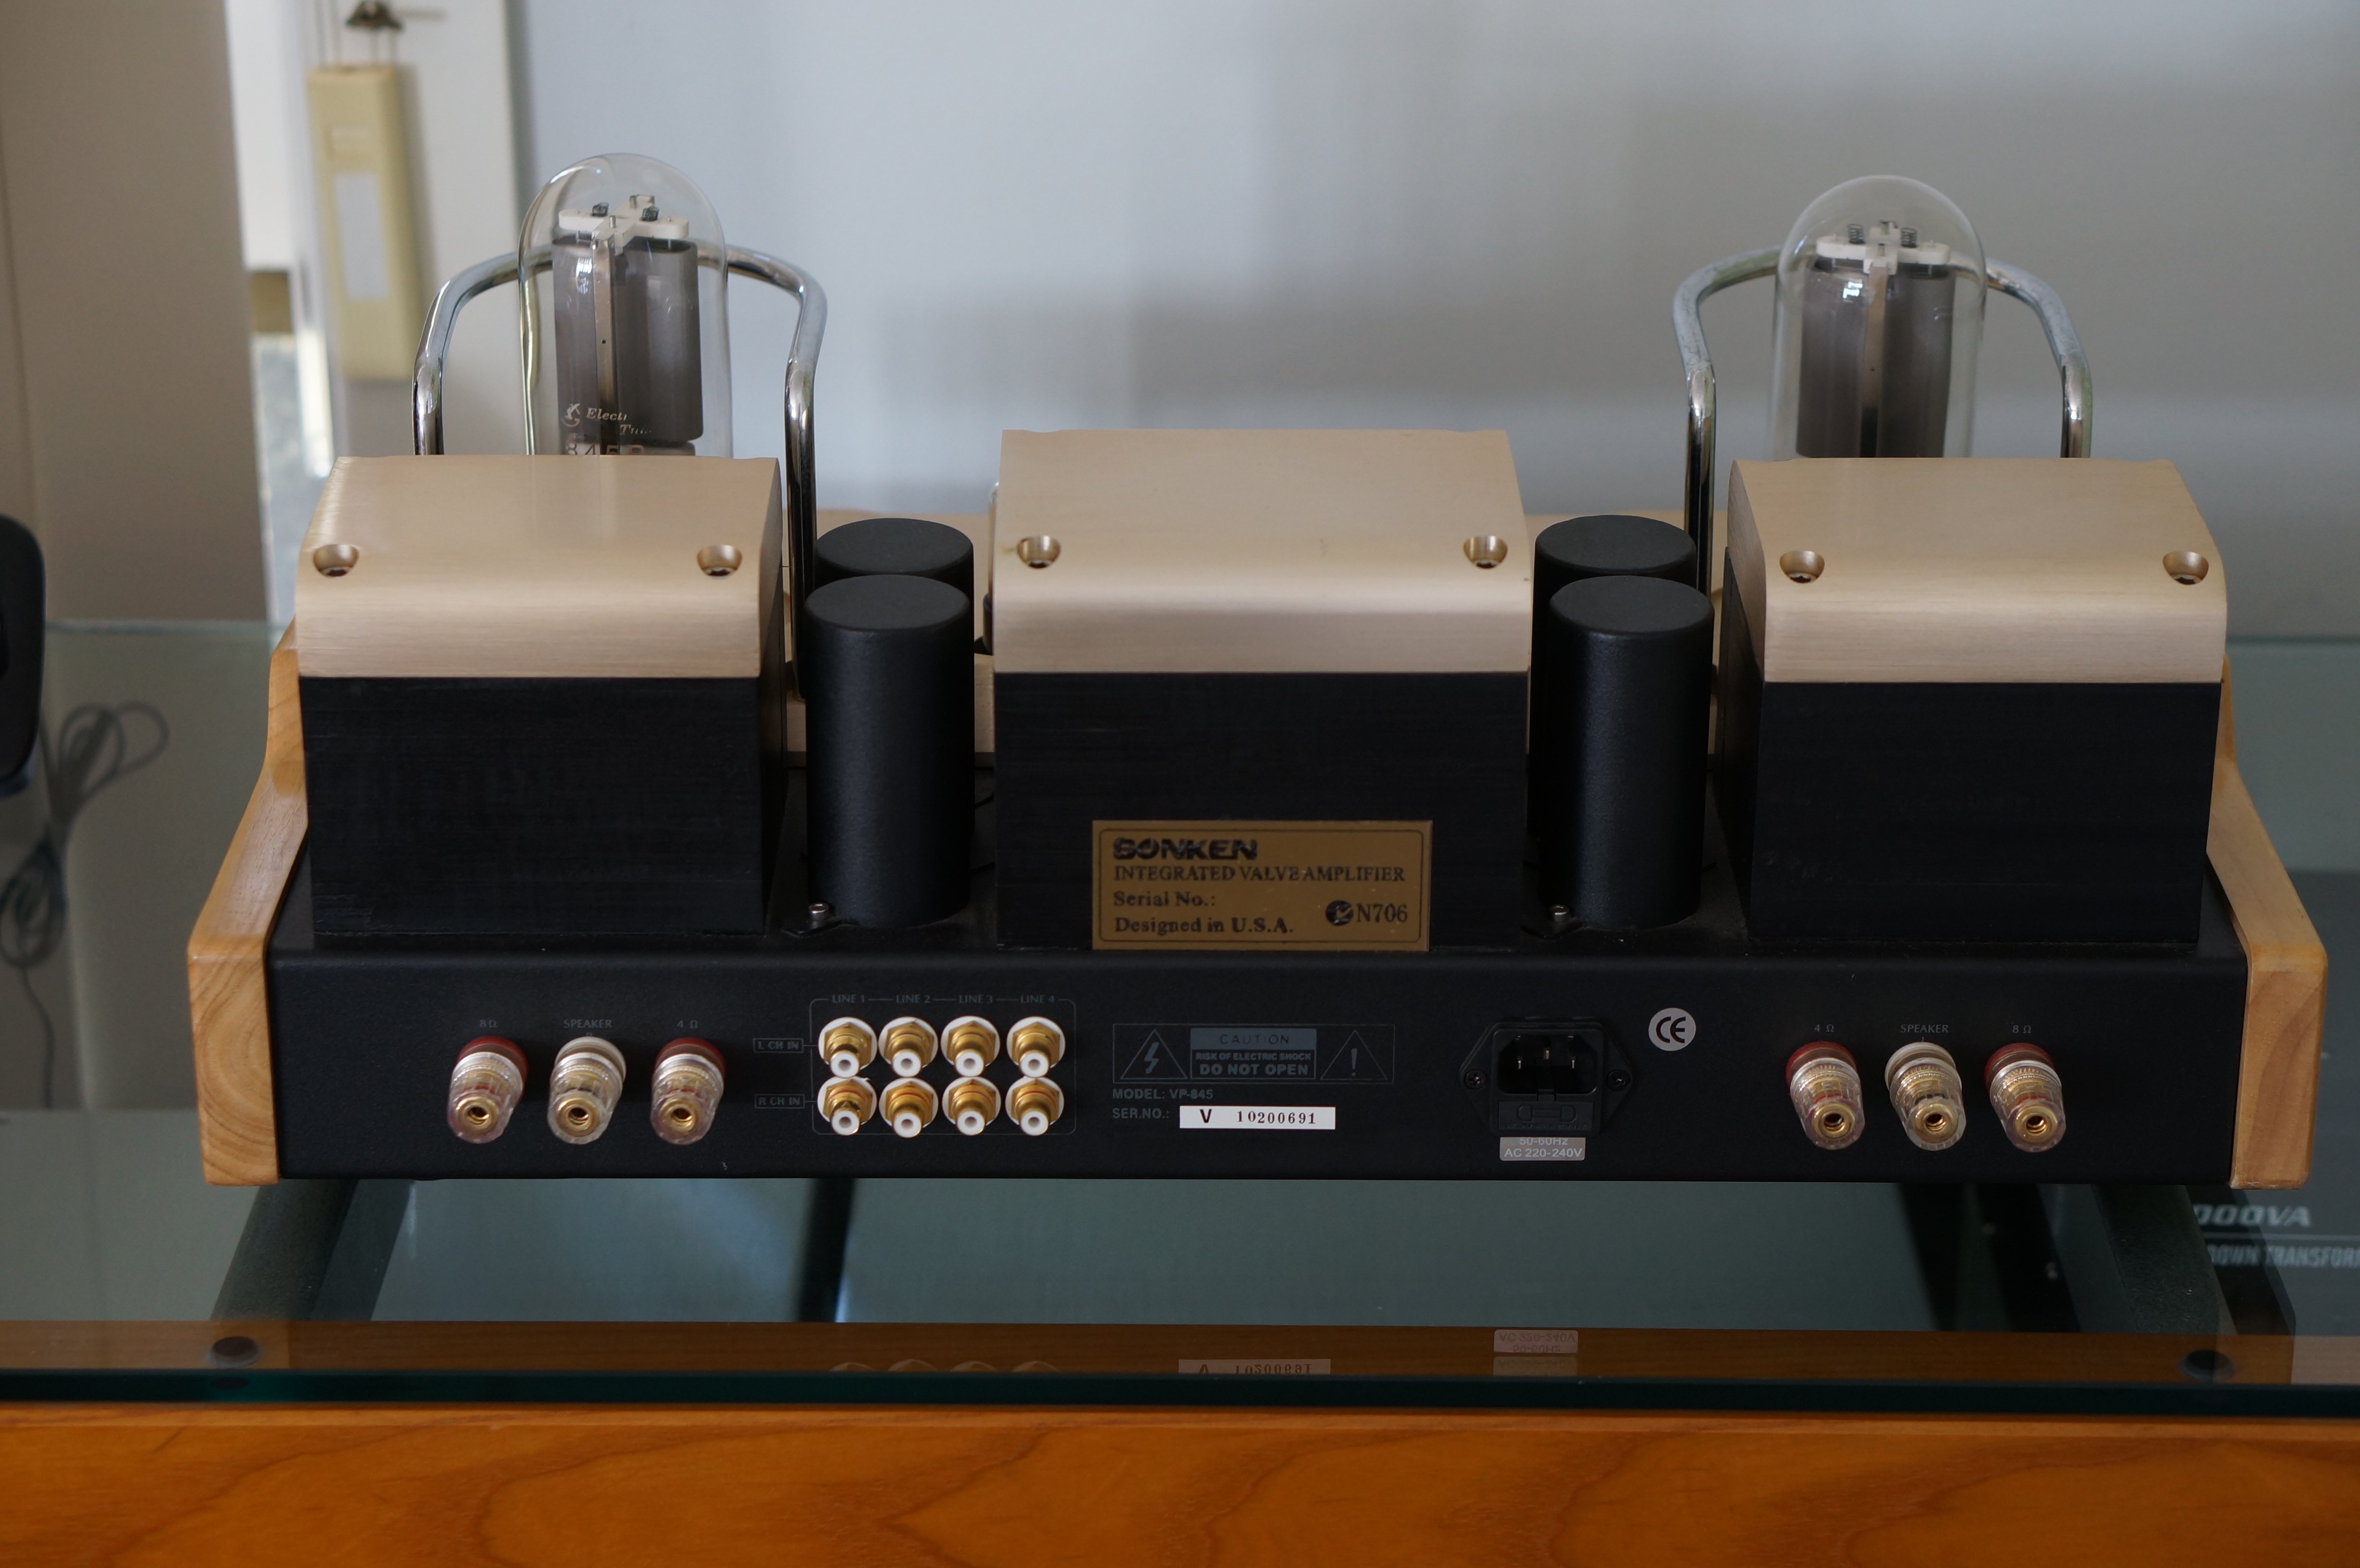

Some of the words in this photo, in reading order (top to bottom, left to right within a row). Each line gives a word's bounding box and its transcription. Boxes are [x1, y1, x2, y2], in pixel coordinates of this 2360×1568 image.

[1113, 837, 1257, 860] SONKEN
[1114, 866, 1235, 881] INTEGRATED
[1241, 866, 1299, 881] VALVE
[1303, 867, 1406, 882] AMPLIFIER
[1114, 891, 1169, 906] Serial
[1175, 892, 1216, 906] No.:
[1357, 904, 1408, 923] N706
[1115, 917, 1201, 935] Designed
[1207, 918, 1225, 932] in
[1231, 918, 1293, 933] U.S.A.
[832, 994, 857, 1004] LINE
[860, 994, 865, 1004] 1
[896, 994, 921, 1004] LINE
[923, 994, 931, 1004] 2
[959, 994, 983, 1004] LINE
[986, 994, 993, 1004] 3
[1020, 994, 1045, 1004] LINE
[1048, 994, 1055, 1004] 4
[563, 1019, 612, 1029] SPEAKER
[1900, 1024, 1949, 1033] SPEAKER
[1220, 1034, 1290, 1045] CAUTION
[758, 1041, 765, 1050] L
[767, 1041, 784, 1050] CH
[787, 1041, 799, 1050] IN
[1196, 1052, 1217, 1061] RISK
[1219, 1052, 1231, 1061] OF
[1233, 1052, 1278, 1061] ELECTRIC
[1279, 1052, 1312, 1061] SHOCK
[1199, 1063, 1223, 1075] DO
[1227, 1063, 1260, 1075] NOT
[1265, 1063, 1309, 1076] OPEN
[1112, 1089, 1165, 1099] MODEL:
[1169, 1089, 1214, 1100] VP-845
[769, 1097, 785, 1105] CH
[789, 1097, 800, 1105] IN
[1200, 1109, 1213, 1123] V
[1237, 1110, 1316, 1125] 10200691
[1519, 1137, 1569, 1146] 50-60Hz
[1504, 1148, 1522, 1157] AC
[1525, 1148, 1583, 1158] 220-240V
